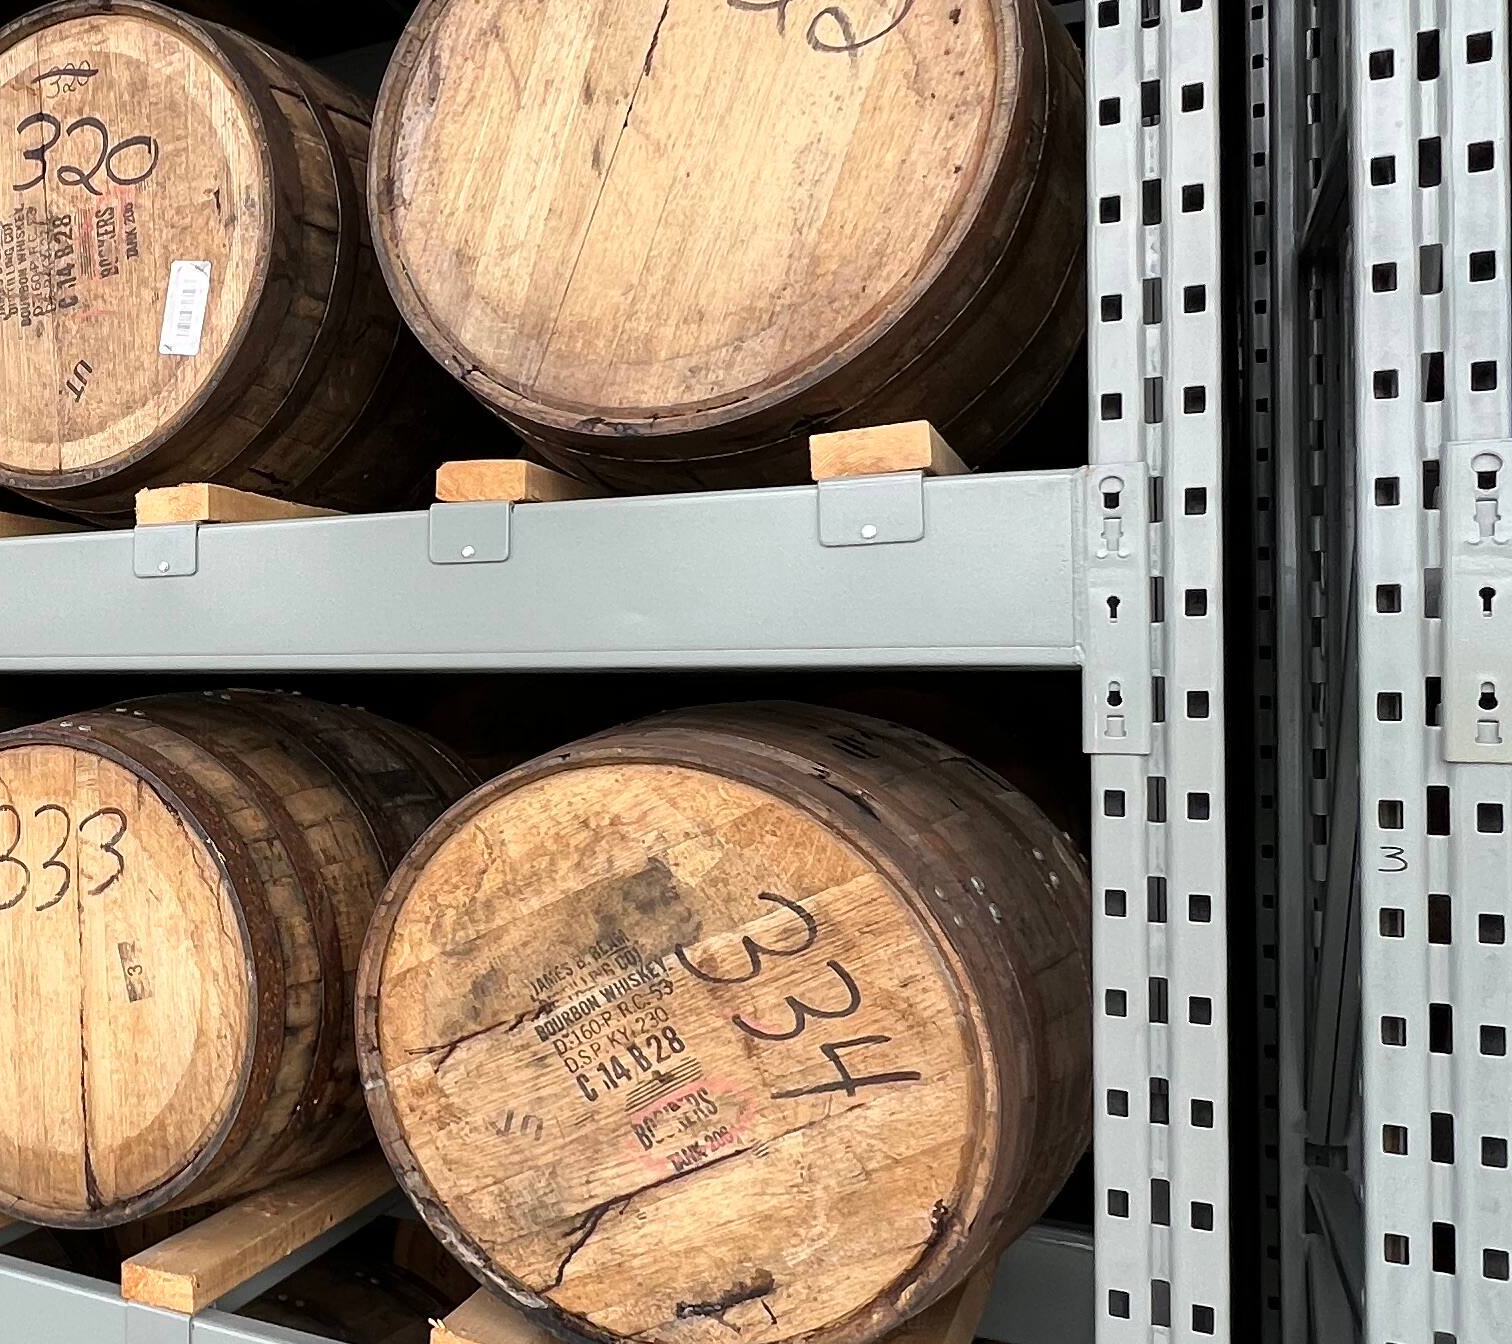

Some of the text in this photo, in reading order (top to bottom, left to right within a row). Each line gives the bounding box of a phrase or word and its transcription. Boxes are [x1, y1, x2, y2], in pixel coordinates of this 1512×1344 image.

[12, 112, 159, 197] 320
[1378, 846, 1408, 872] 3
[675, 892, 922, 1102] 334
[534, 994, 602, 1043] BOURBON
[634, 1006, 670, 1035] 230
[576, 1072, 599, 1102] C
